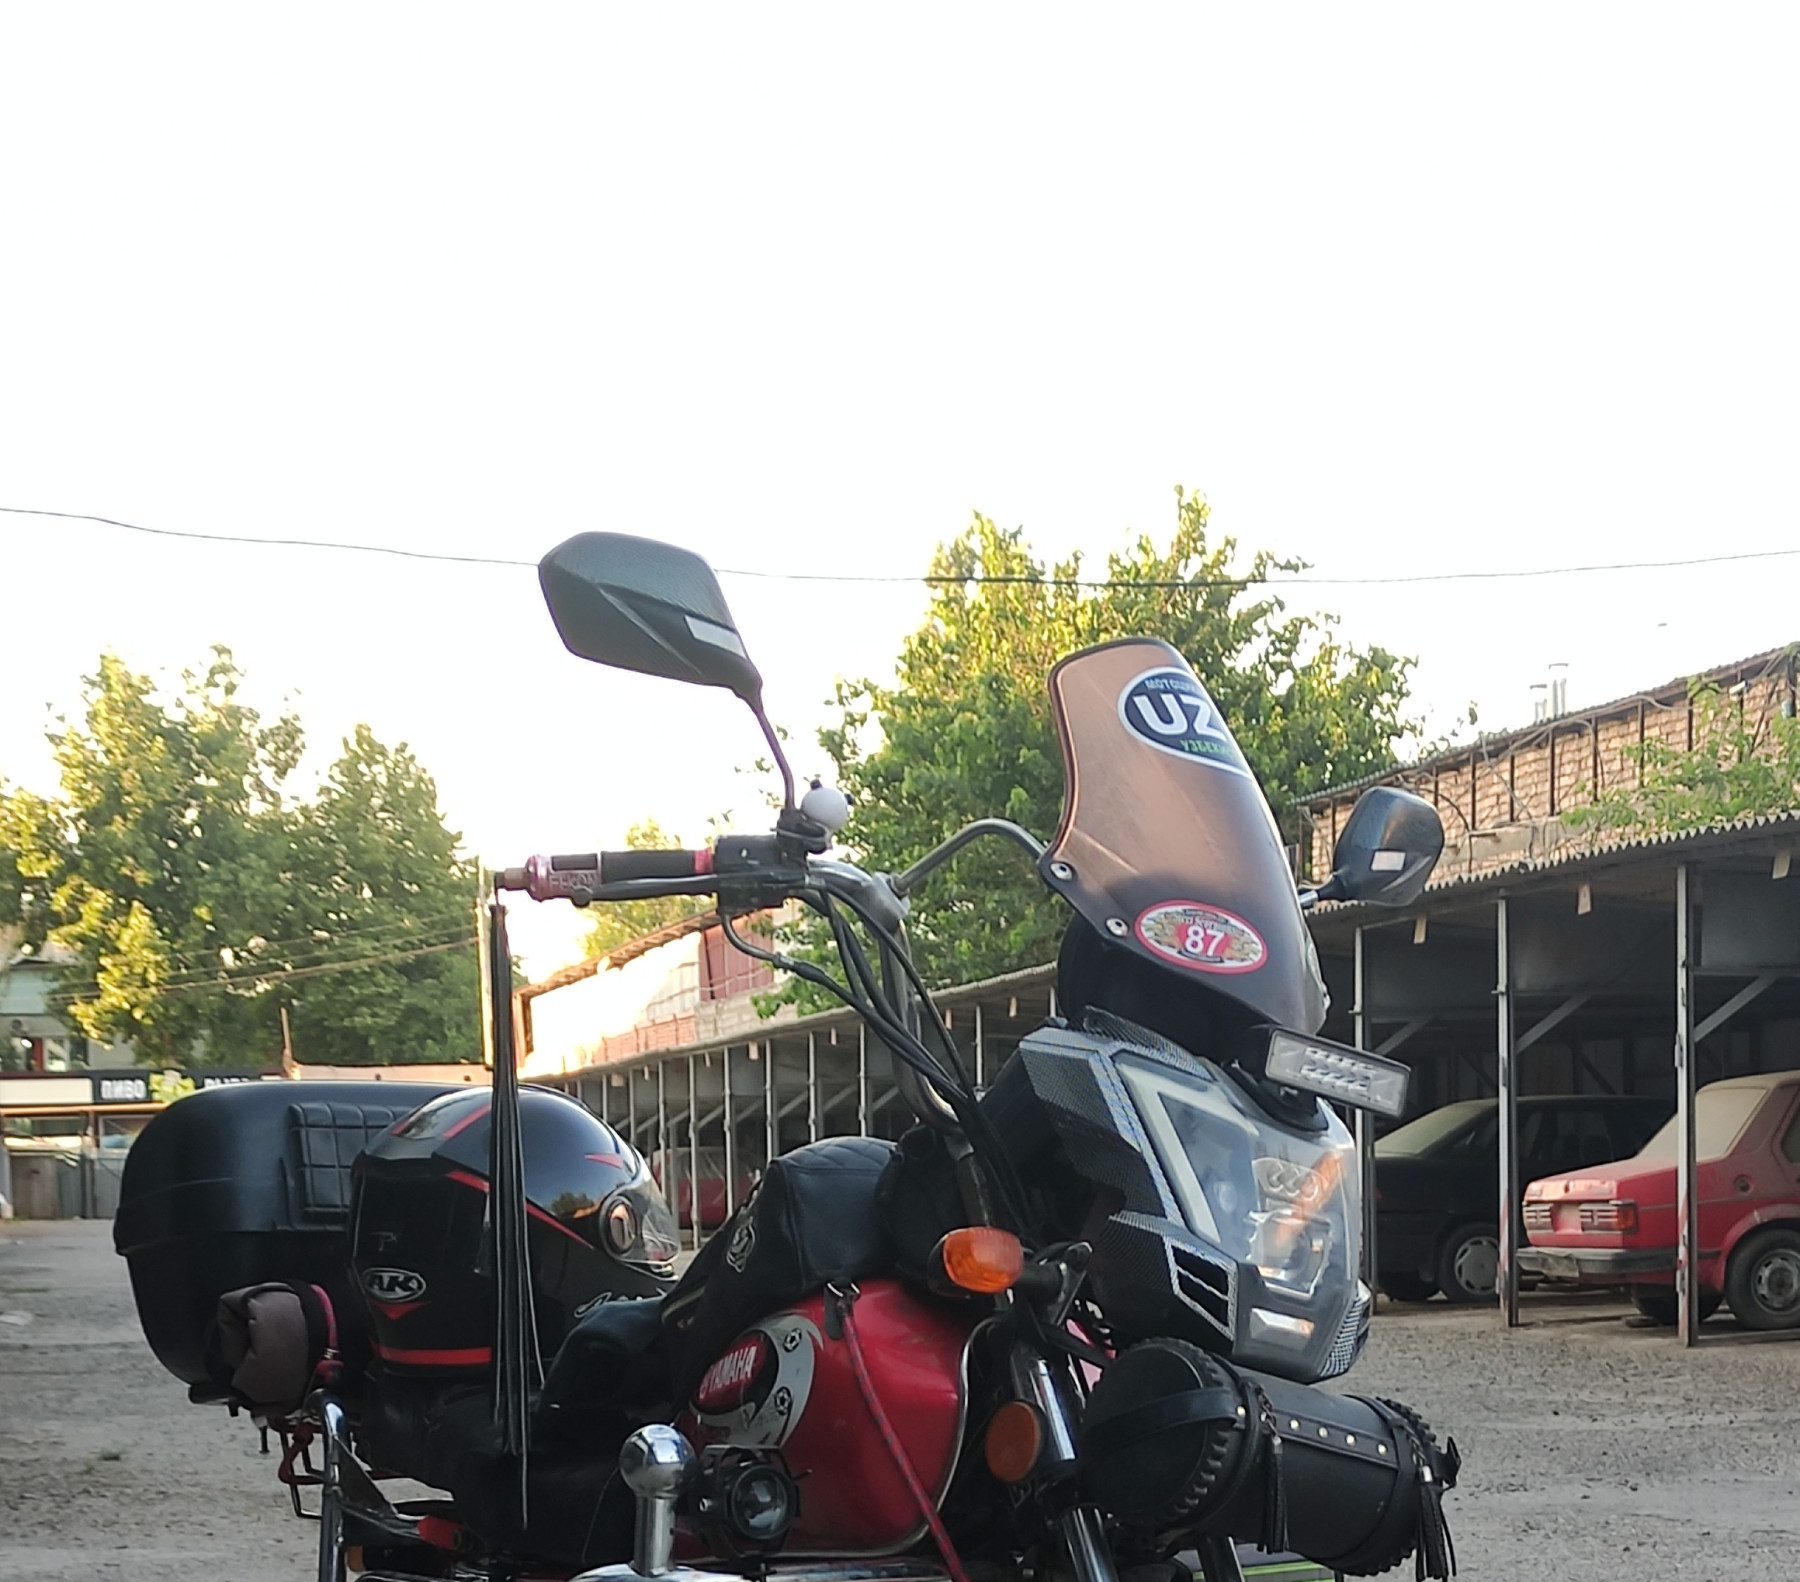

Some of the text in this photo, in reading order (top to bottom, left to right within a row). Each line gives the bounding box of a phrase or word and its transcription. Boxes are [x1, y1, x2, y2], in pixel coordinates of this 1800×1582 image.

[1132, 693, 1228, 743] UZ
[1185, 925, 1225, 957] 87
[101, 1078, 146, 1100] ПИВО
[707, 1346, 757, 1394] YAMAHA
